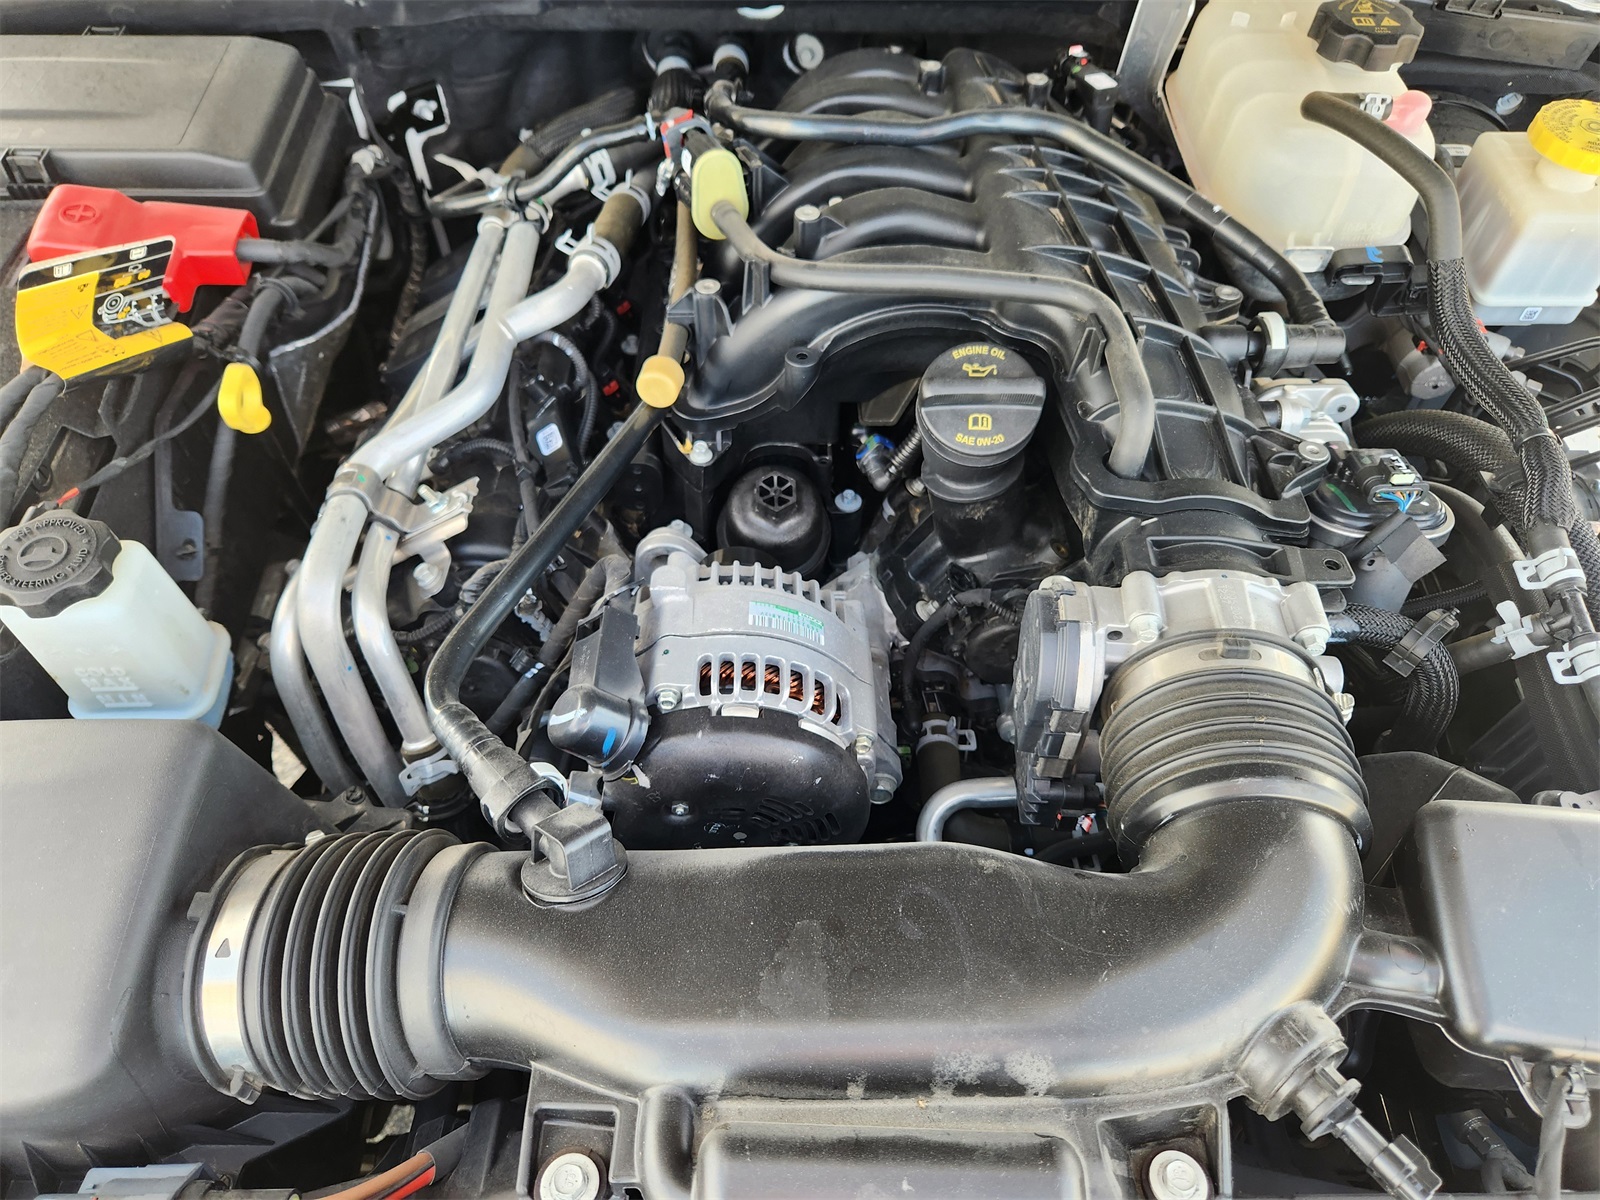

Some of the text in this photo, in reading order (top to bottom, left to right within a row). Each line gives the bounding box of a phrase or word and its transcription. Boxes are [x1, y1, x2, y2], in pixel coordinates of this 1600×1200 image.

[952, 345, 1006, 360] ENGINE OIL
[955, 433, 1005, 446] SAE 0W-20
[10, 518, 87, 541] USE APPROVED
[10, 572, 65, 588] STEERING
[66, 547, 89, 572] FLUID
